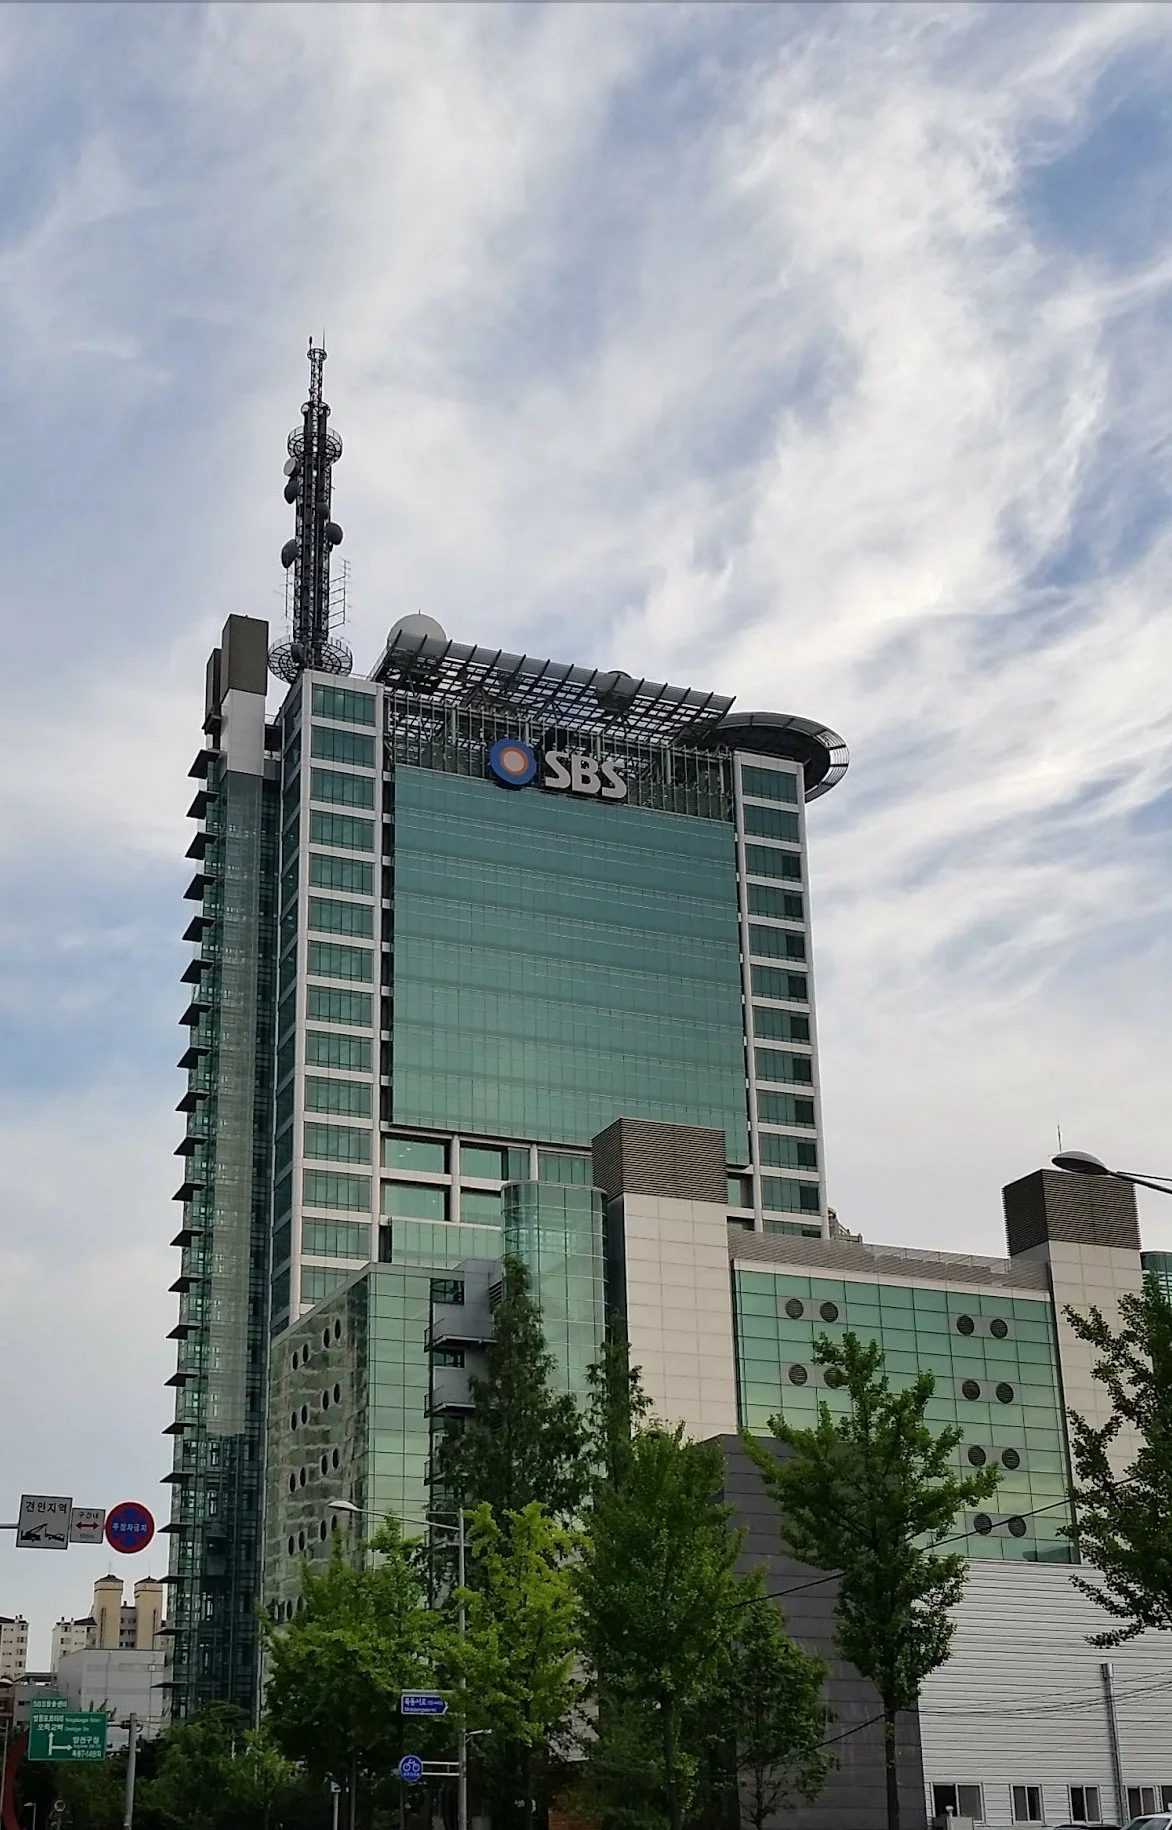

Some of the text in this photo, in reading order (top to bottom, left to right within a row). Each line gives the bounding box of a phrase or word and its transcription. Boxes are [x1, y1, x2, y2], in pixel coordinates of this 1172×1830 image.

[545, 750, 627, 798] SBS
[25, 1501, 68, 1514] 견인지역
[79, 1511, 99, 1519] 구간내
[112, 1522, 148, 1533] 주정차금지
[37, 1723, 64, 1732] 오목교역
